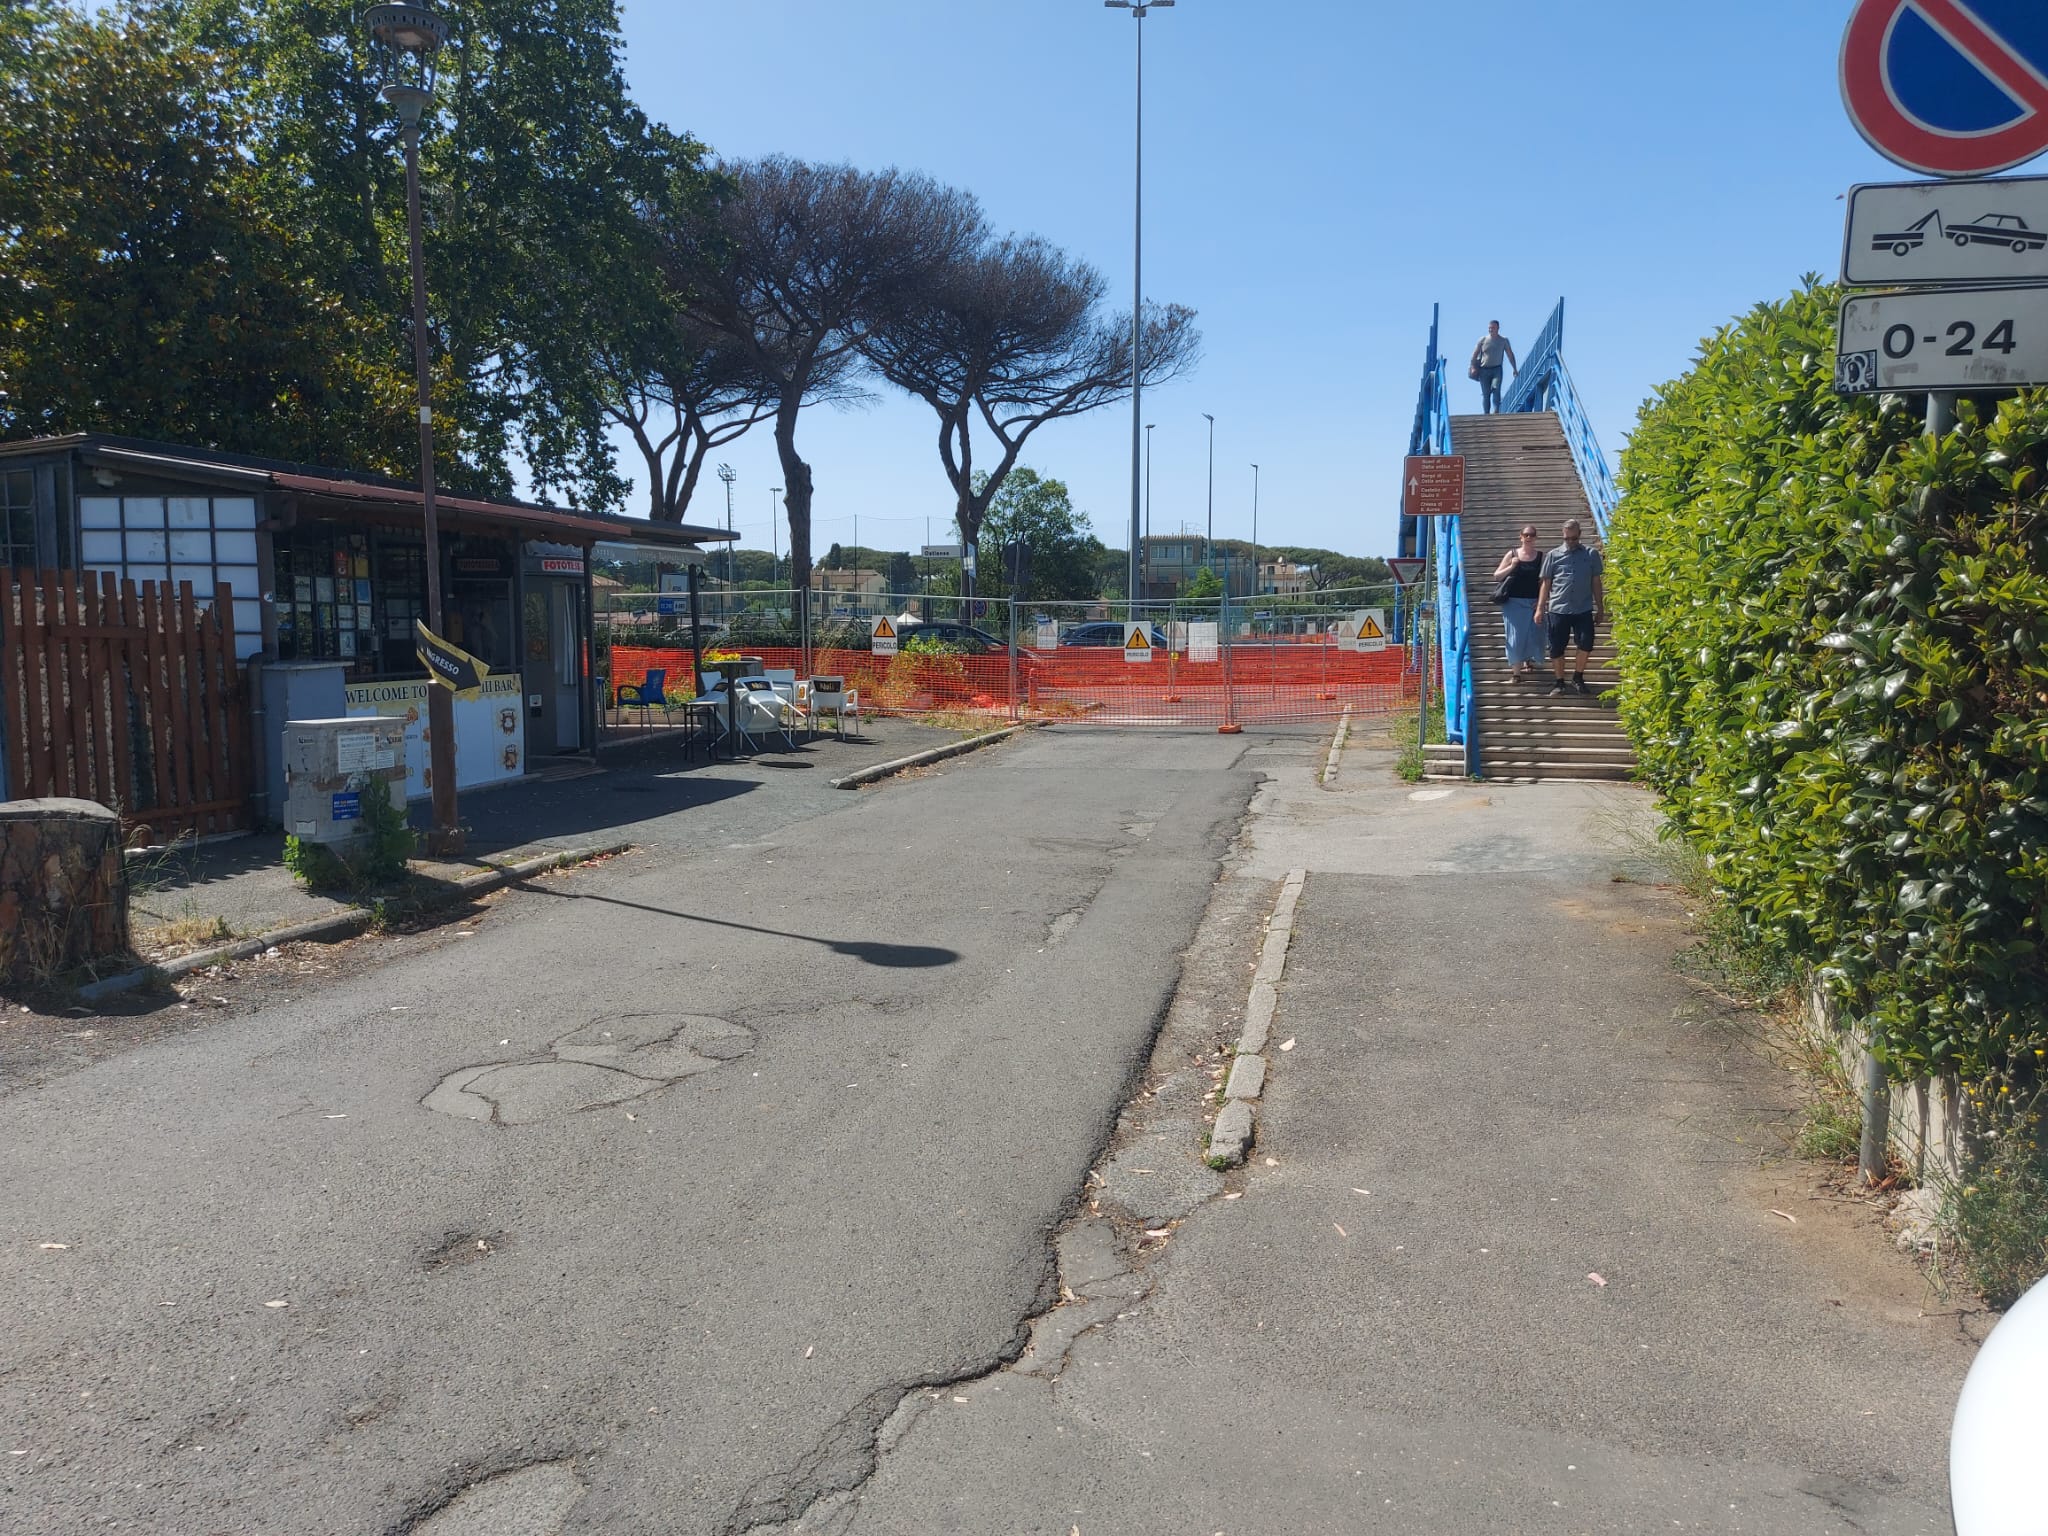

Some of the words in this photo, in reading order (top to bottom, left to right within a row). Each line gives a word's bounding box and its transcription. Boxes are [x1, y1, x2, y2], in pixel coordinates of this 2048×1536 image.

[1882, 319, 2016, 360] 0-24
[872, 641, 897, 650] PERICOLO
[1358, 640, 1383, 648] PERICOLO
[426, 647, 460, 676] INGRESSO
[345, 687, 409, 703] WELCOME
[412, 685, 428, 699] TO
[494, 679, 514, 692] BAR
